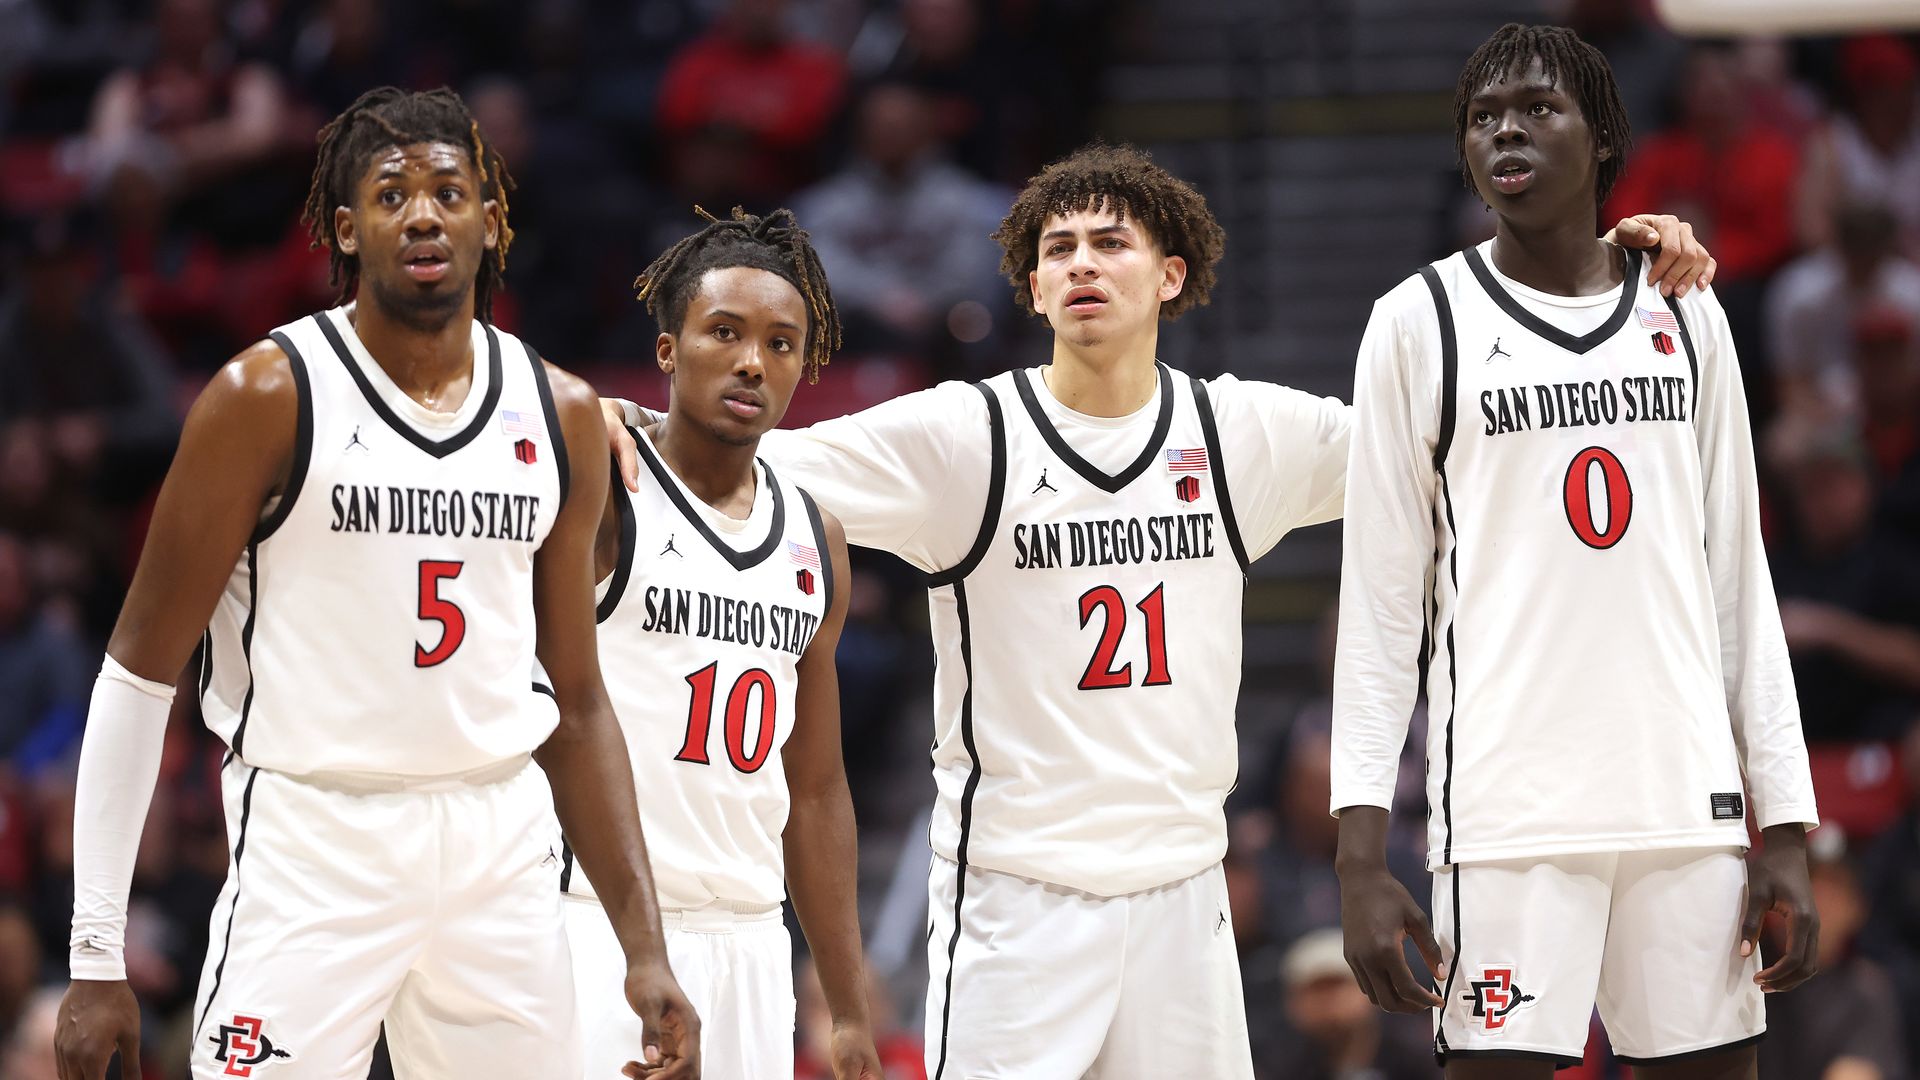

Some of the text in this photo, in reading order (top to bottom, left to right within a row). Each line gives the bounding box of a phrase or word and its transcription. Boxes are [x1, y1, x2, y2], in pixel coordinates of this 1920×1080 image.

[1480, 376, 1686, 436] SAN DIEGO STATE
[331, 484, 540, 542] SAN DIEGO STATE
[1563, 446, 1633, 550] 0
[1014, 513, 1214, 569] SAN DIEGO STATE
[414, 559, 466, 668] 5
[642, 586, 691, 636] SAN
[696, 592, 765, 648] DIEGO
[1078, 581, 1172, 690] 21
[673, 660, 776, 774] 10
